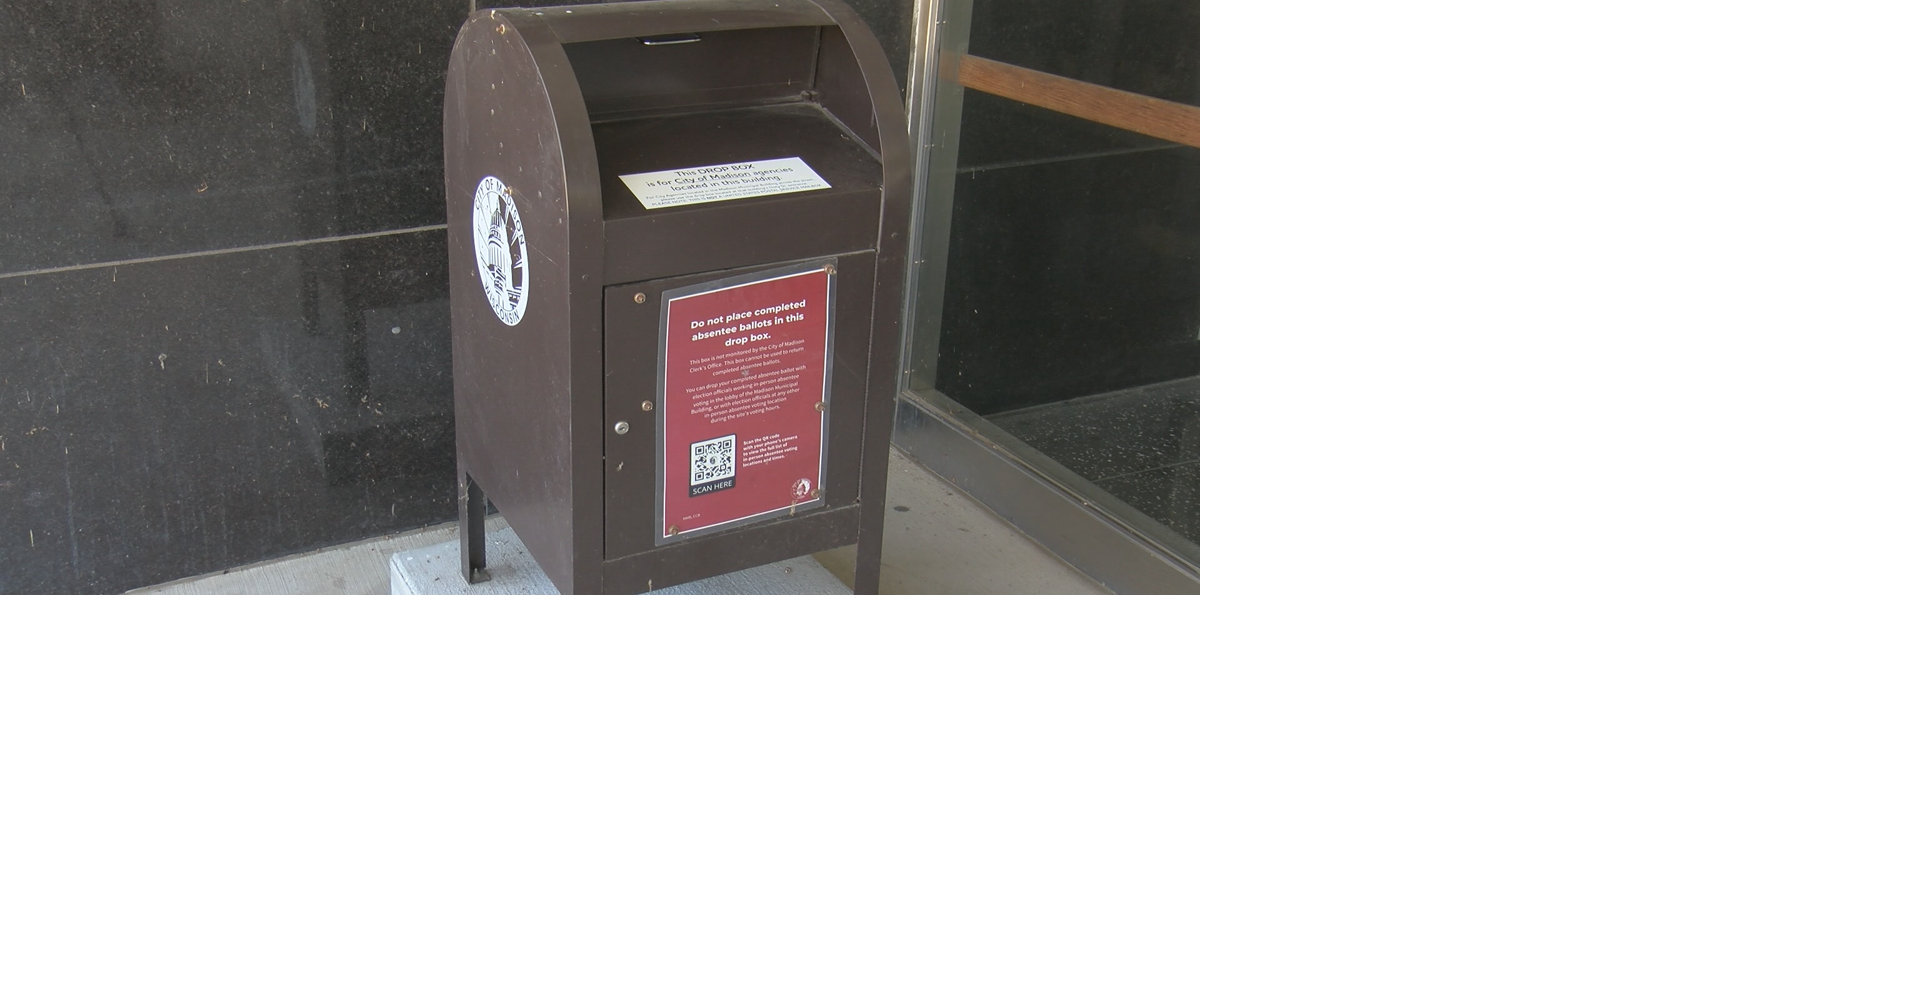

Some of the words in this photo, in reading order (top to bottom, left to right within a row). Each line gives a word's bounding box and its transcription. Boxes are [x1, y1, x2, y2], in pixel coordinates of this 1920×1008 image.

[697, 166, 729, 174] DROP
[709, 171, 752, 180] Madison
[752, 167, 794, 176] agencies
[670, 182, 708, 192] located
[740, 175, 782, 184] building.
[475, 184, 484, 210] CITY
[484, 178, 493, 191] OF
[485, 281, 520, 324] WISCONSIN
[690, 320, 704, 329] Do
[706, 316, 724, 326] not
[726, 310, 752, 324] place
[754, 300, 806, 316] completed
[692, 326, 738, 341] absentee
[740, 318, 772, 331] ballots
[774, 316, 784, 325] in
[786, 312, 804, 323] this
[724, 335, 748, 346] drop
[750, 332, 772, 342] box.
[725, 348, 752, 358] monitored
[712, 366, 740, 376] completed
[740, 362, 762, 370] absentee
[730, 374, 758, 384] completed
[758, 370, 780, 378] absentee
[692, 392, 713, 400] election
[712, 387, 732, 396] officials
[732, 384, 753, 392] working
[777, 374, 800, 382] absentee
[754, 386, 775, 394] Madison
[774, 381, 798, 390] Municipal
[728, 404, 750, 413] absentee
[767, 396, 787, 404] location
[732, 398, 752, 406] election
[764, 449, 784, 457] absentee
[692, 484, 713, 494] SCAN
[714, 480, 732, 490] HERE
